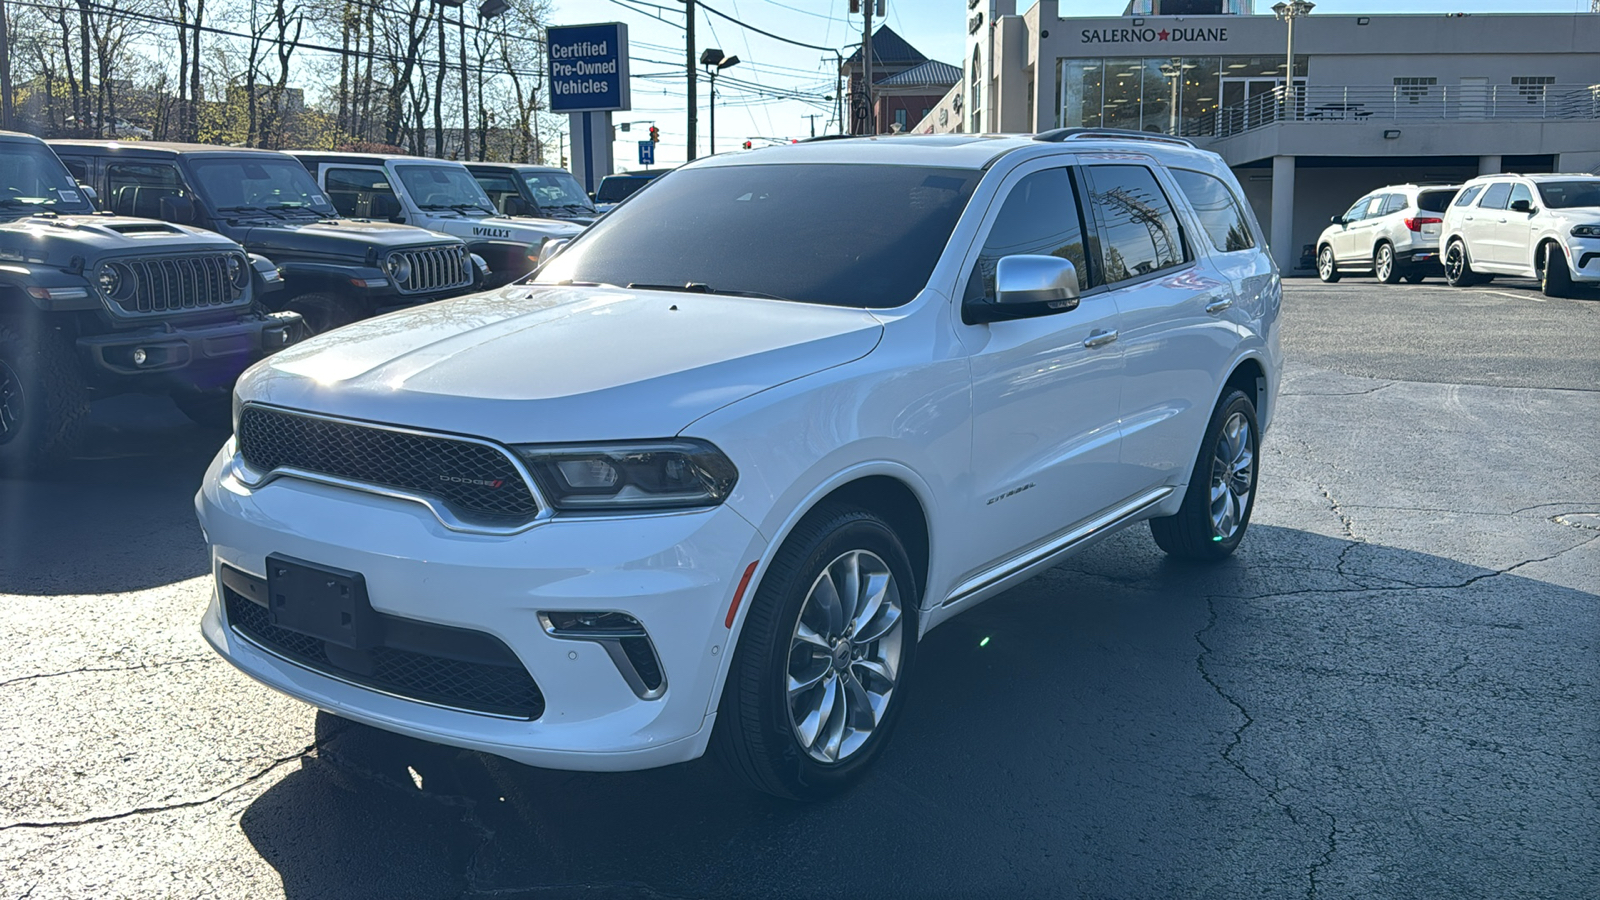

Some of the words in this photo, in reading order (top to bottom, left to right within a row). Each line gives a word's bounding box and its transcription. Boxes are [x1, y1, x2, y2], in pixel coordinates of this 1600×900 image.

[1081, 28, 1156, 43] SALERNO
[1171, 28, 1228, 42] DUANE
[551, 40, 607, 58] Certified
[552, 58, 616, 77] Pre-Owned
[553, 79, 609, 95] Vehicles
[641, 146, 651, 158] H
[472, 226, 512, 238] WILLYS
[439, 475, 495, 487] DODGE
